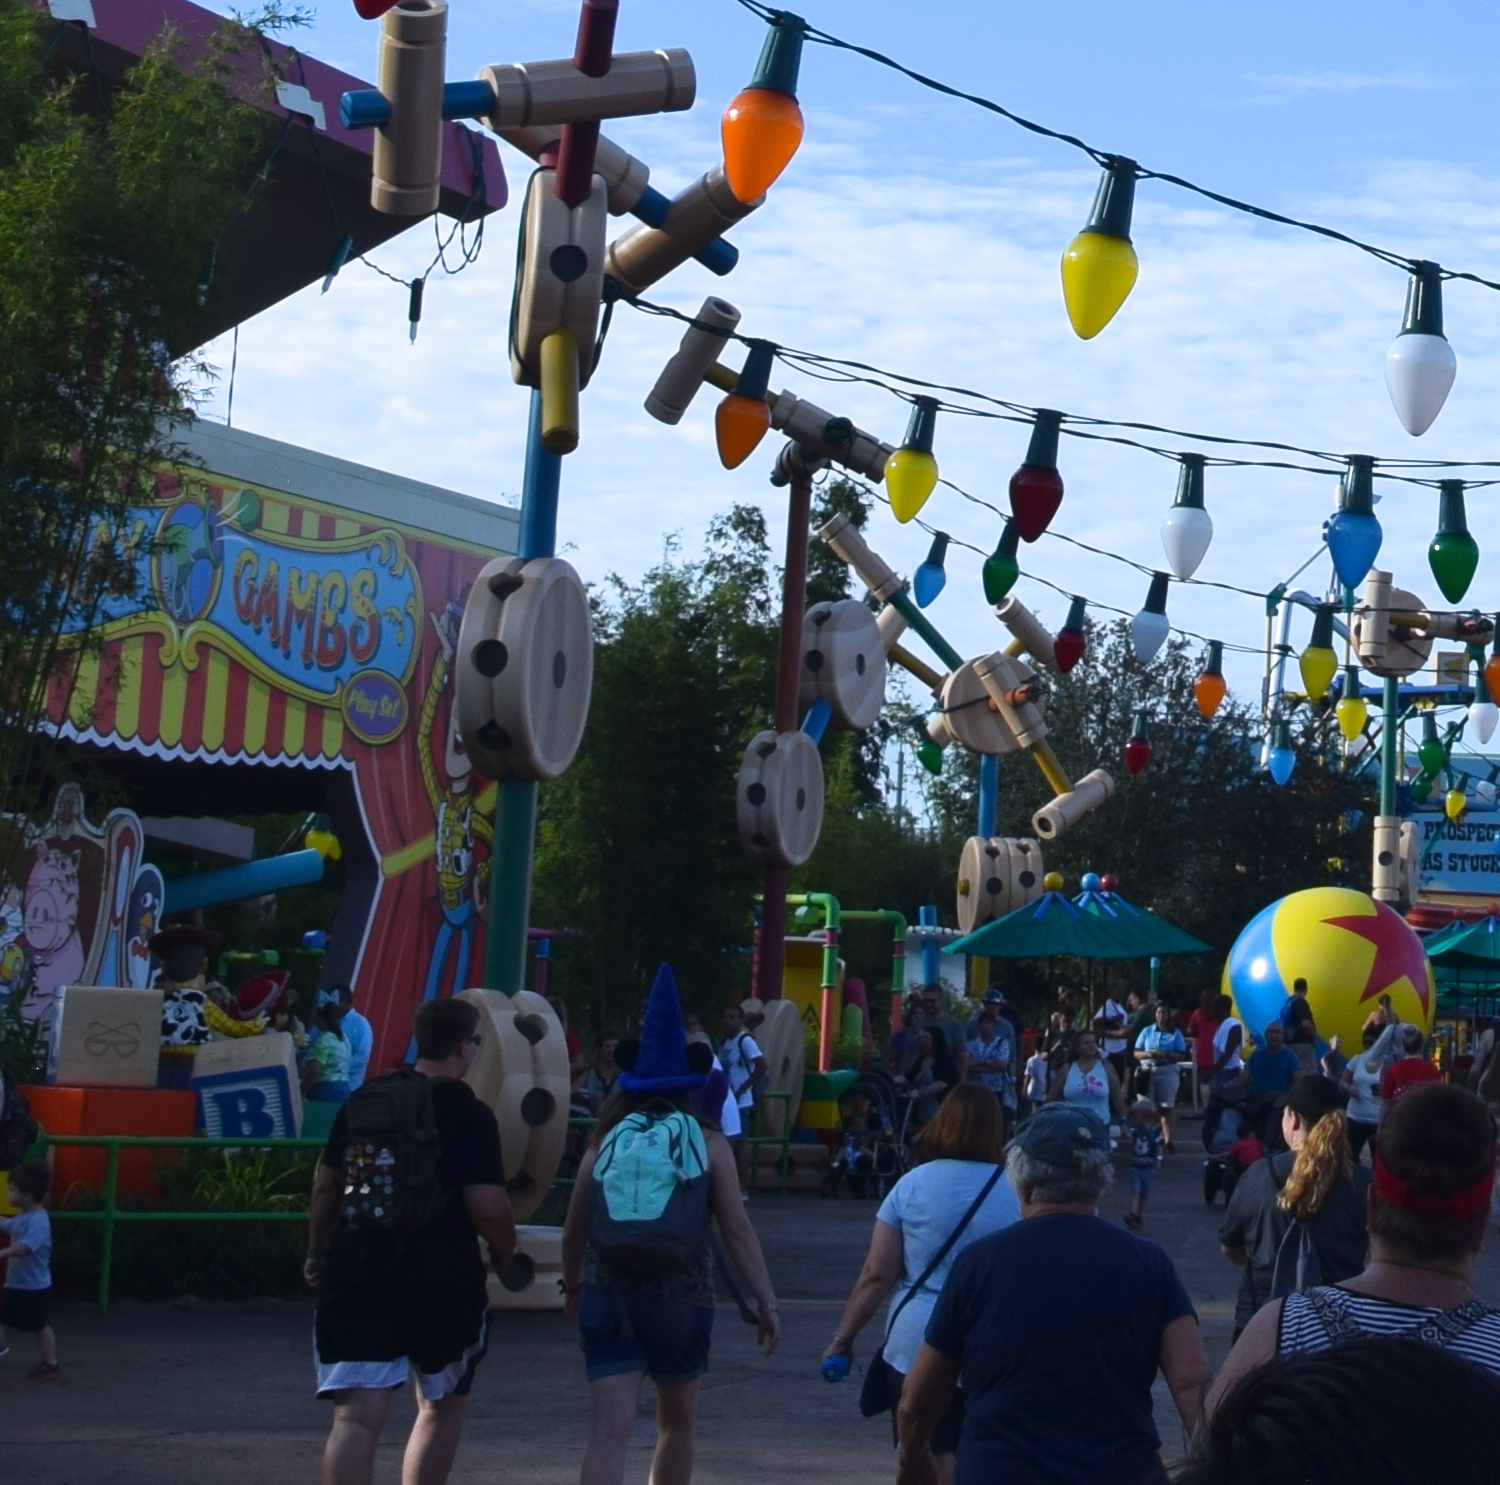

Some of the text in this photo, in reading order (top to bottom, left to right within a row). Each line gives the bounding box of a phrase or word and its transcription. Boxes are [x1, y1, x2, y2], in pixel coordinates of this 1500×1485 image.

[232, 548, 381, 669] GAMES
[347, 688, 377, 722] Play
[212, 1087, 274, 1138] B
